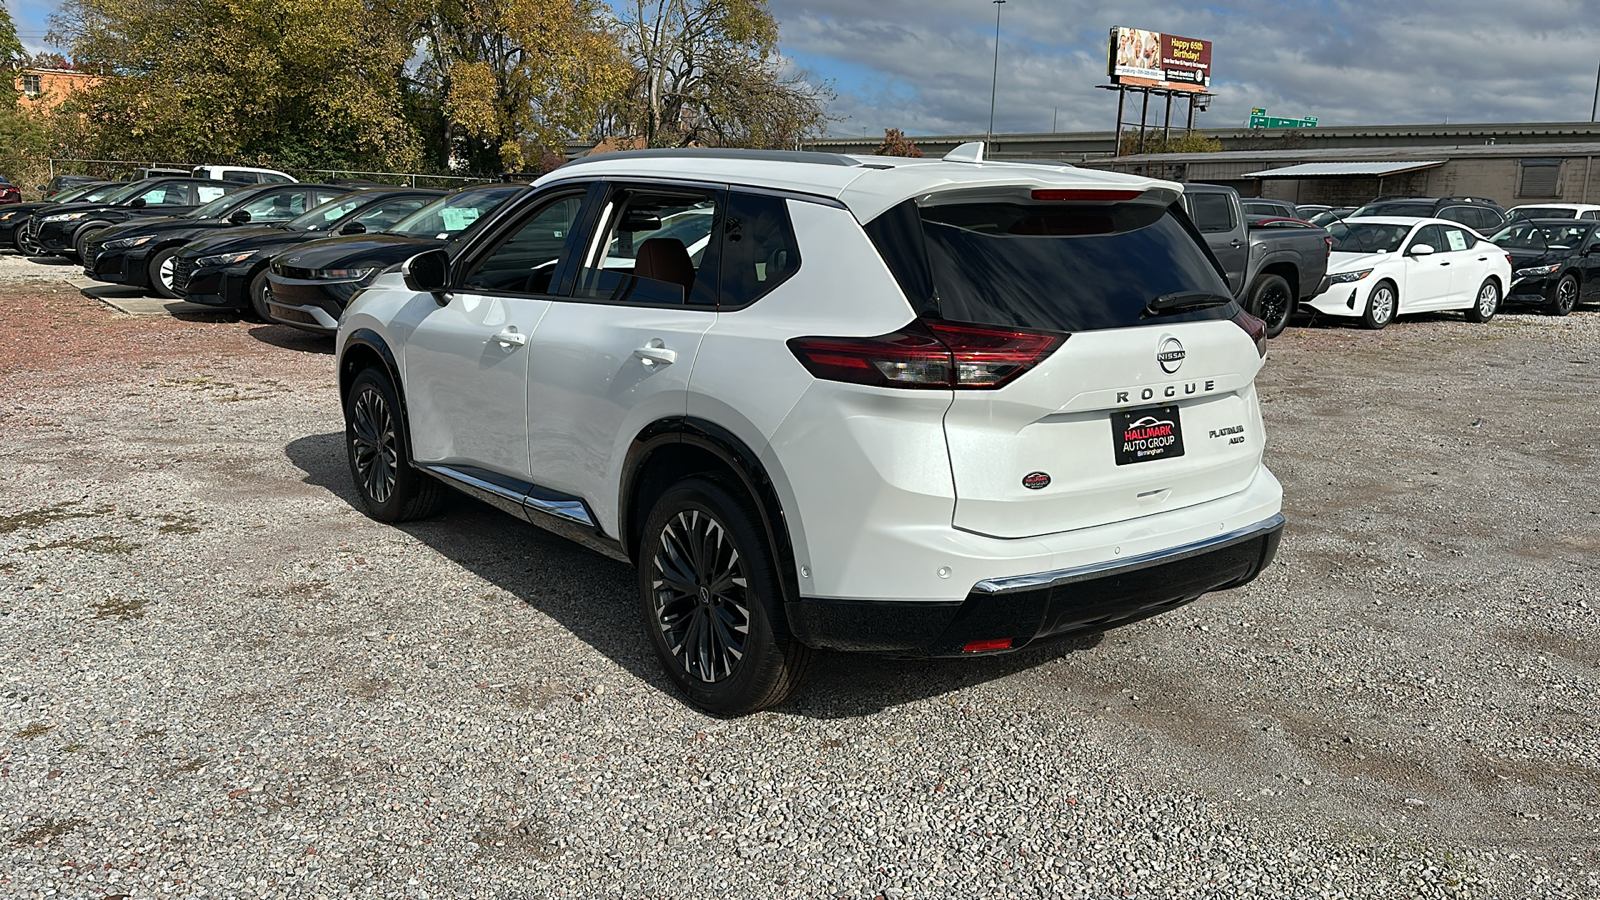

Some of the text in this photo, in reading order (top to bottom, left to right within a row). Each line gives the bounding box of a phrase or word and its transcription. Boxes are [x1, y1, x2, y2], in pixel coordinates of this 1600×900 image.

[1171, 38, 1203, 51] Happy 65th
[1173, 48, 1200, 62] Birthday!
[1158, 352, 1185, 360] NISSAN
[1116, 380, 1215, 403] ROGUE
[1124, 425, 1172, 441] HALLMARK
[1209, 425, 1244, 439] PLATINUM
[1123, 435, 1175, 453] AUTO GROUP
[1228, 436, 1245, 445] AWD
[1137, 447, 1164, 457] Birmingham
